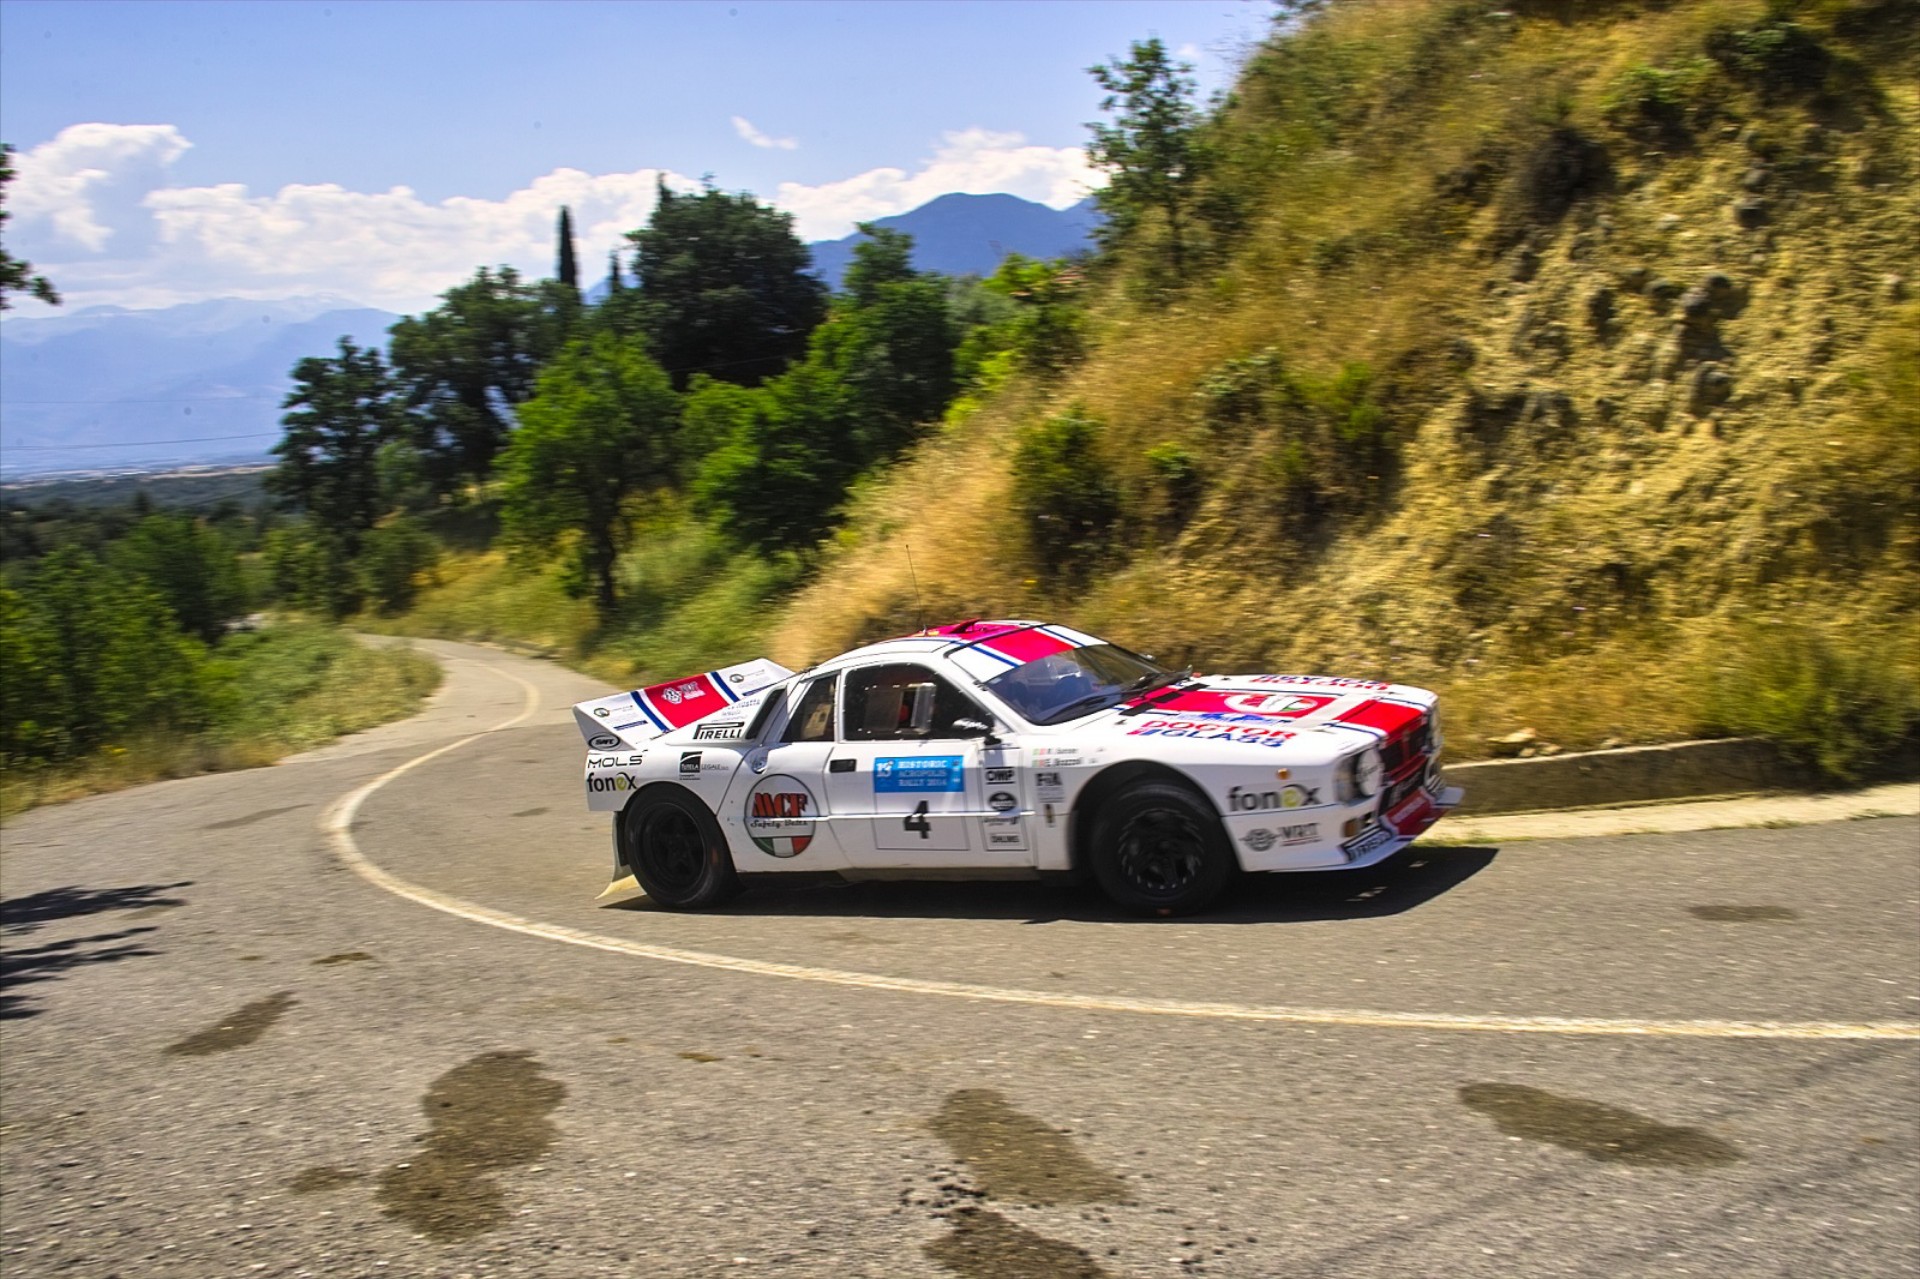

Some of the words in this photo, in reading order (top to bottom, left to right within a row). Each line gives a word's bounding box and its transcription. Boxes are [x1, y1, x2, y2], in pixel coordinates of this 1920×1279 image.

[692, 722, 745, 740] PIRELLI
[1141, 720, 1297, 739] DOCTOR
[587, 755, 643, 769] MOLS
[897, 760, 948, 769] HISTORIC
[587, 772, 637, 793] fonex
[985, 770, 1015, 781] OMP
[1227, 784, 1322, 812] fonex
[903, 800, 932, 839] 4
